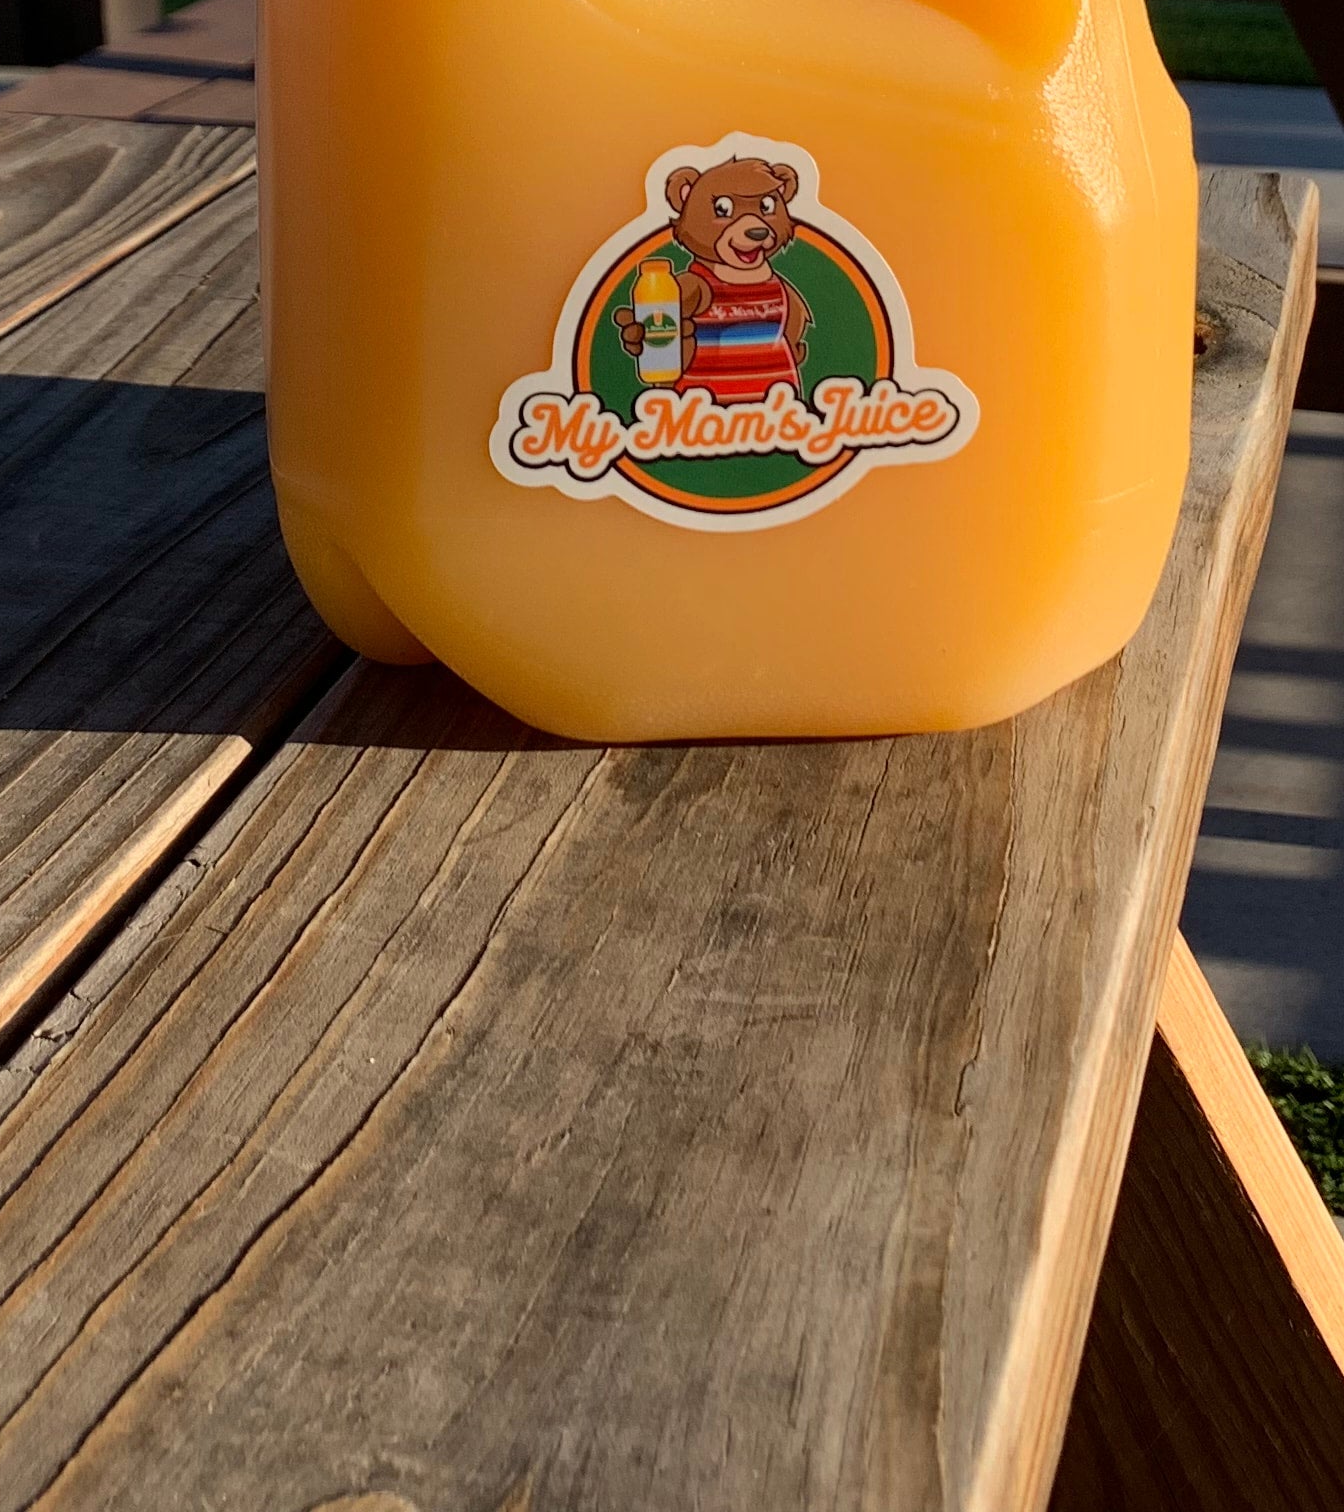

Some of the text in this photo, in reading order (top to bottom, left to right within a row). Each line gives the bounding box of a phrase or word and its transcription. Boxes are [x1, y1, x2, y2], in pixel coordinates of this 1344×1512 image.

[522, 384, 947, 469] My Mom's Juice
